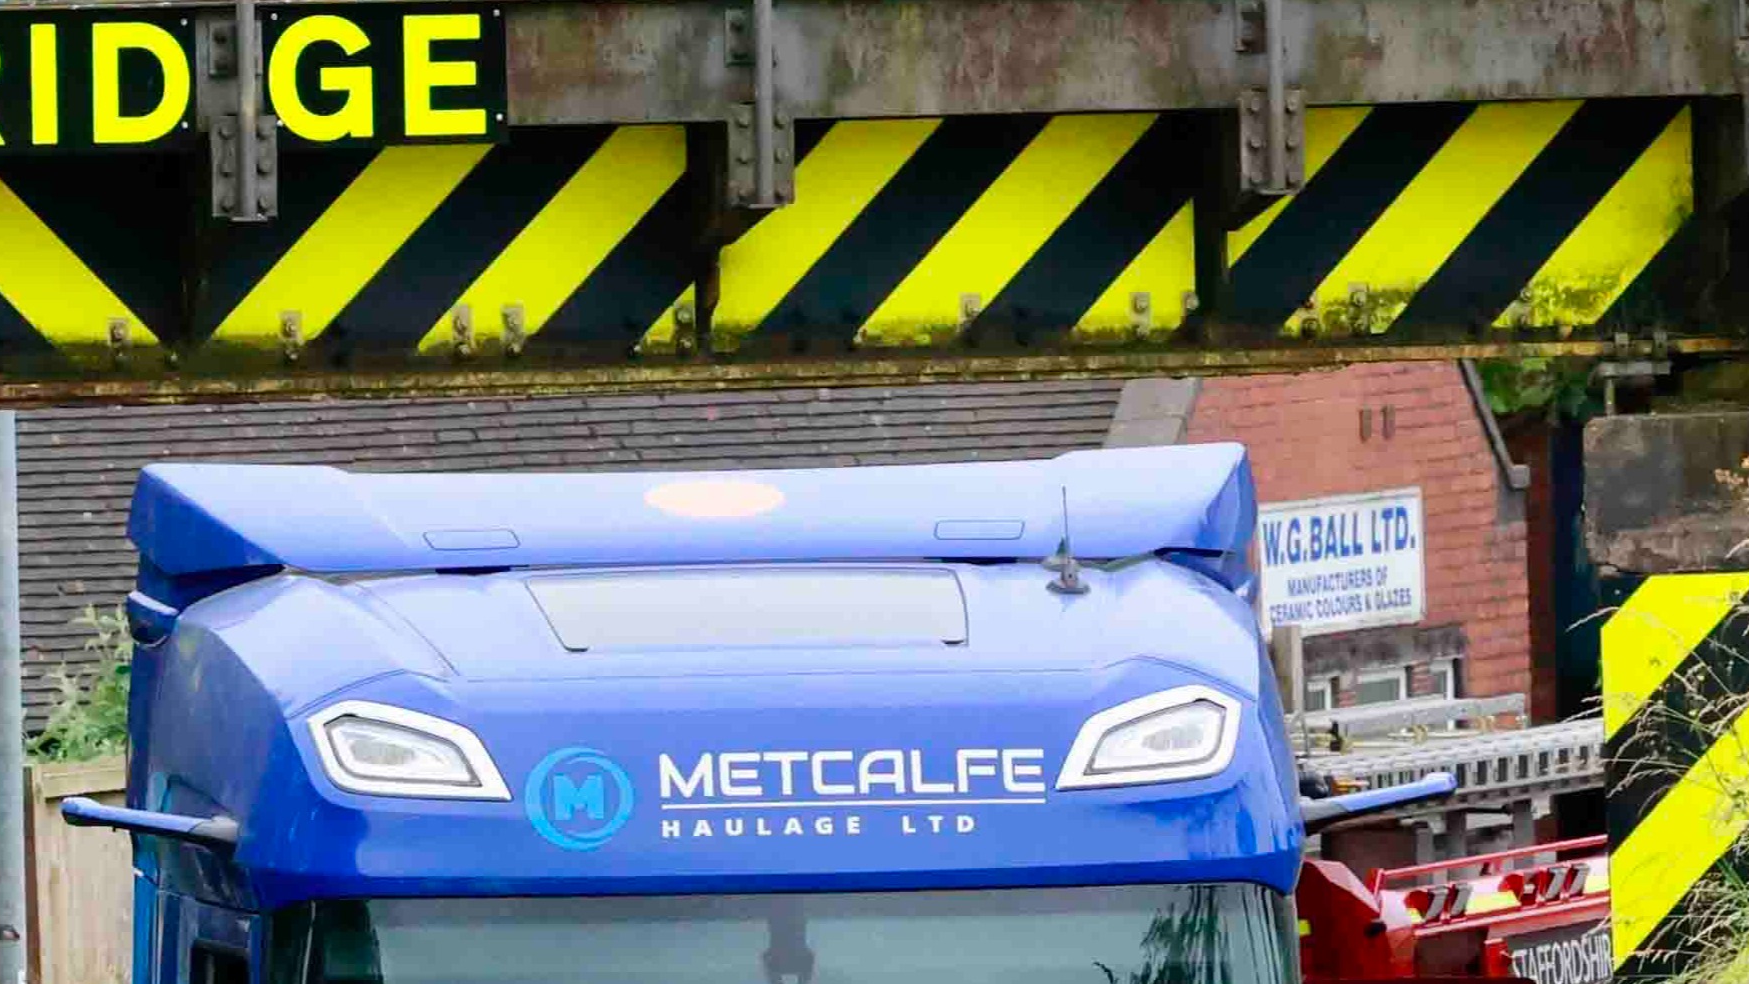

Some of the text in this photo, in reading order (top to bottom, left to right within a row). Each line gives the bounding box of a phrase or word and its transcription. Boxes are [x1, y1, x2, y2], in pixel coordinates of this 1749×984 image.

[1371, 506, 1416, 554] LTD.
[1288, 565, 1388, 597] MANUFACTURERS OF
[1316, 593, 1363, 618] COLOURS
[659, 748, 1045, 798] METCALFE
[662, 815, 976, 838] HAULAGE LTD
